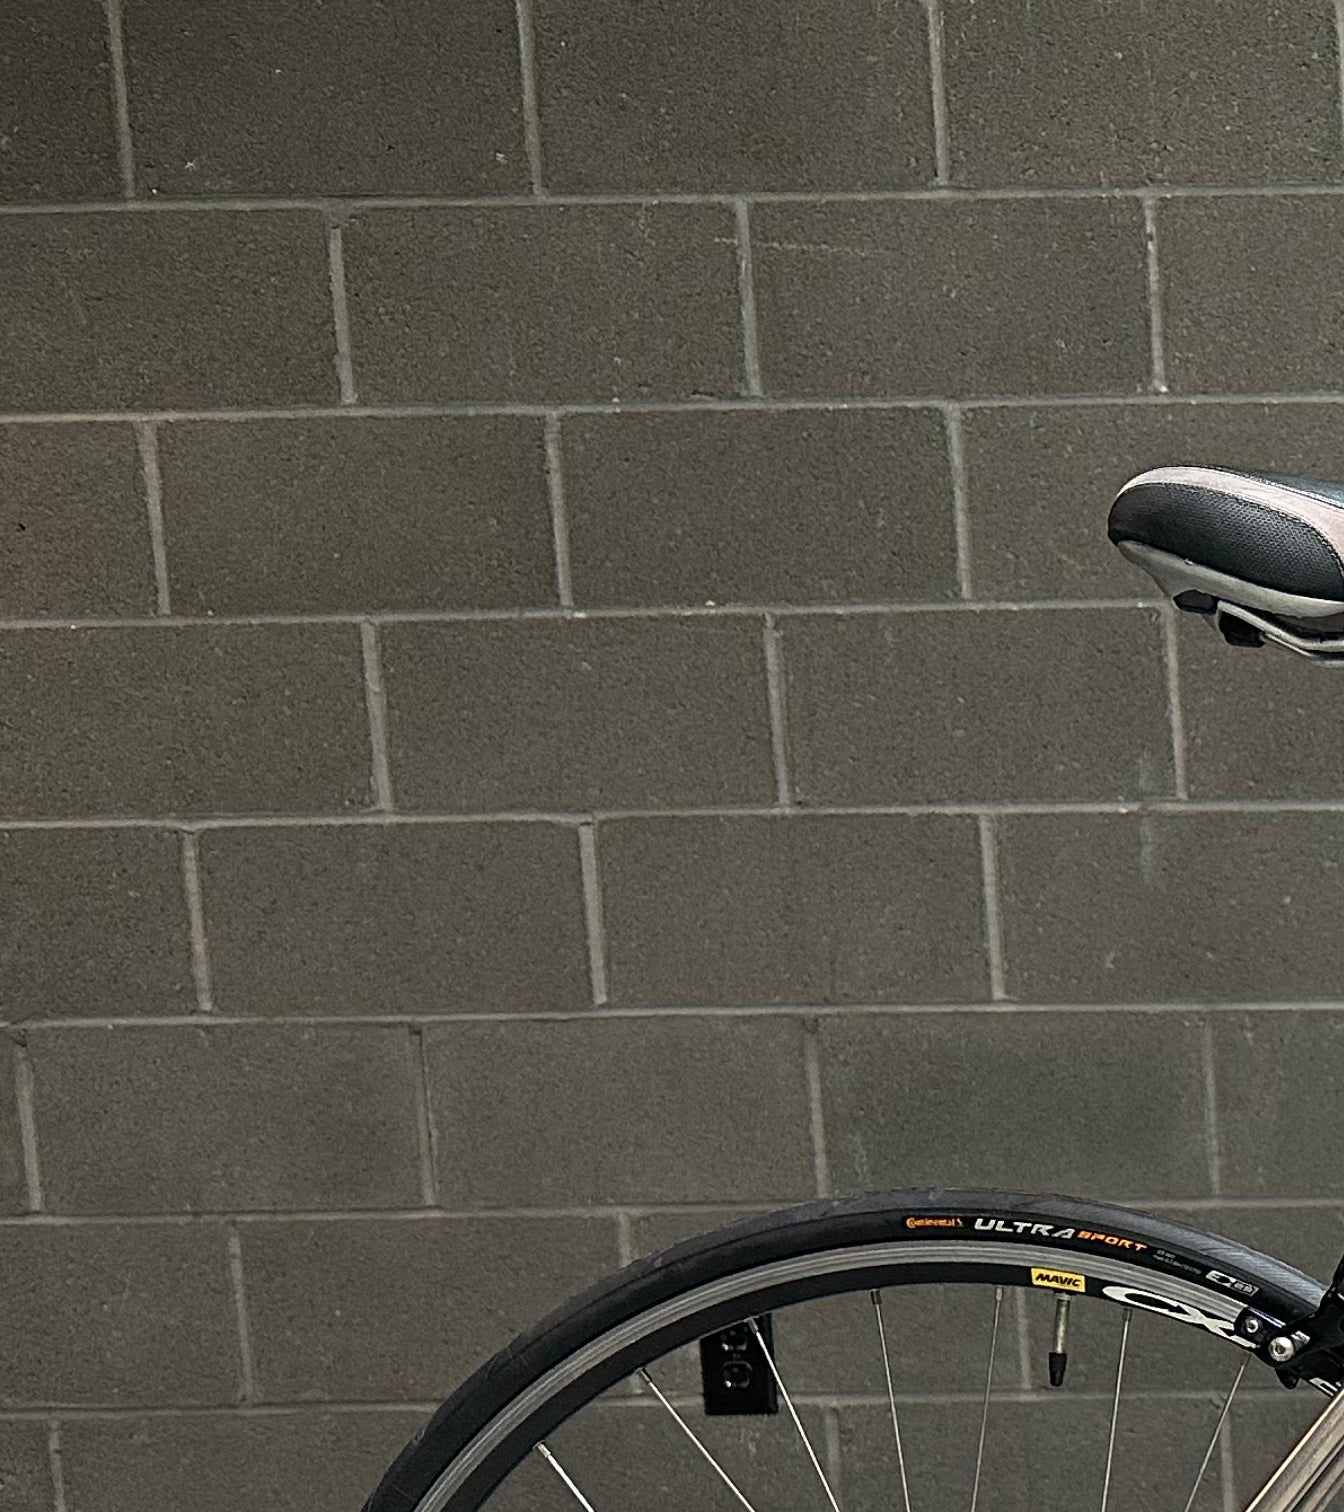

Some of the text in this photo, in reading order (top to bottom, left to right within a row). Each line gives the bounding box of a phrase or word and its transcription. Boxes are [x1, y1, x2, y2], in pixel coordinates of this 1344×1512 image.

[906, 1216, 1148, 1252] Continental ULTRA SPORT
[1035, 1273, 1082, 1288] MAVIC
[1102, 1286, 1262, 1350] CX
